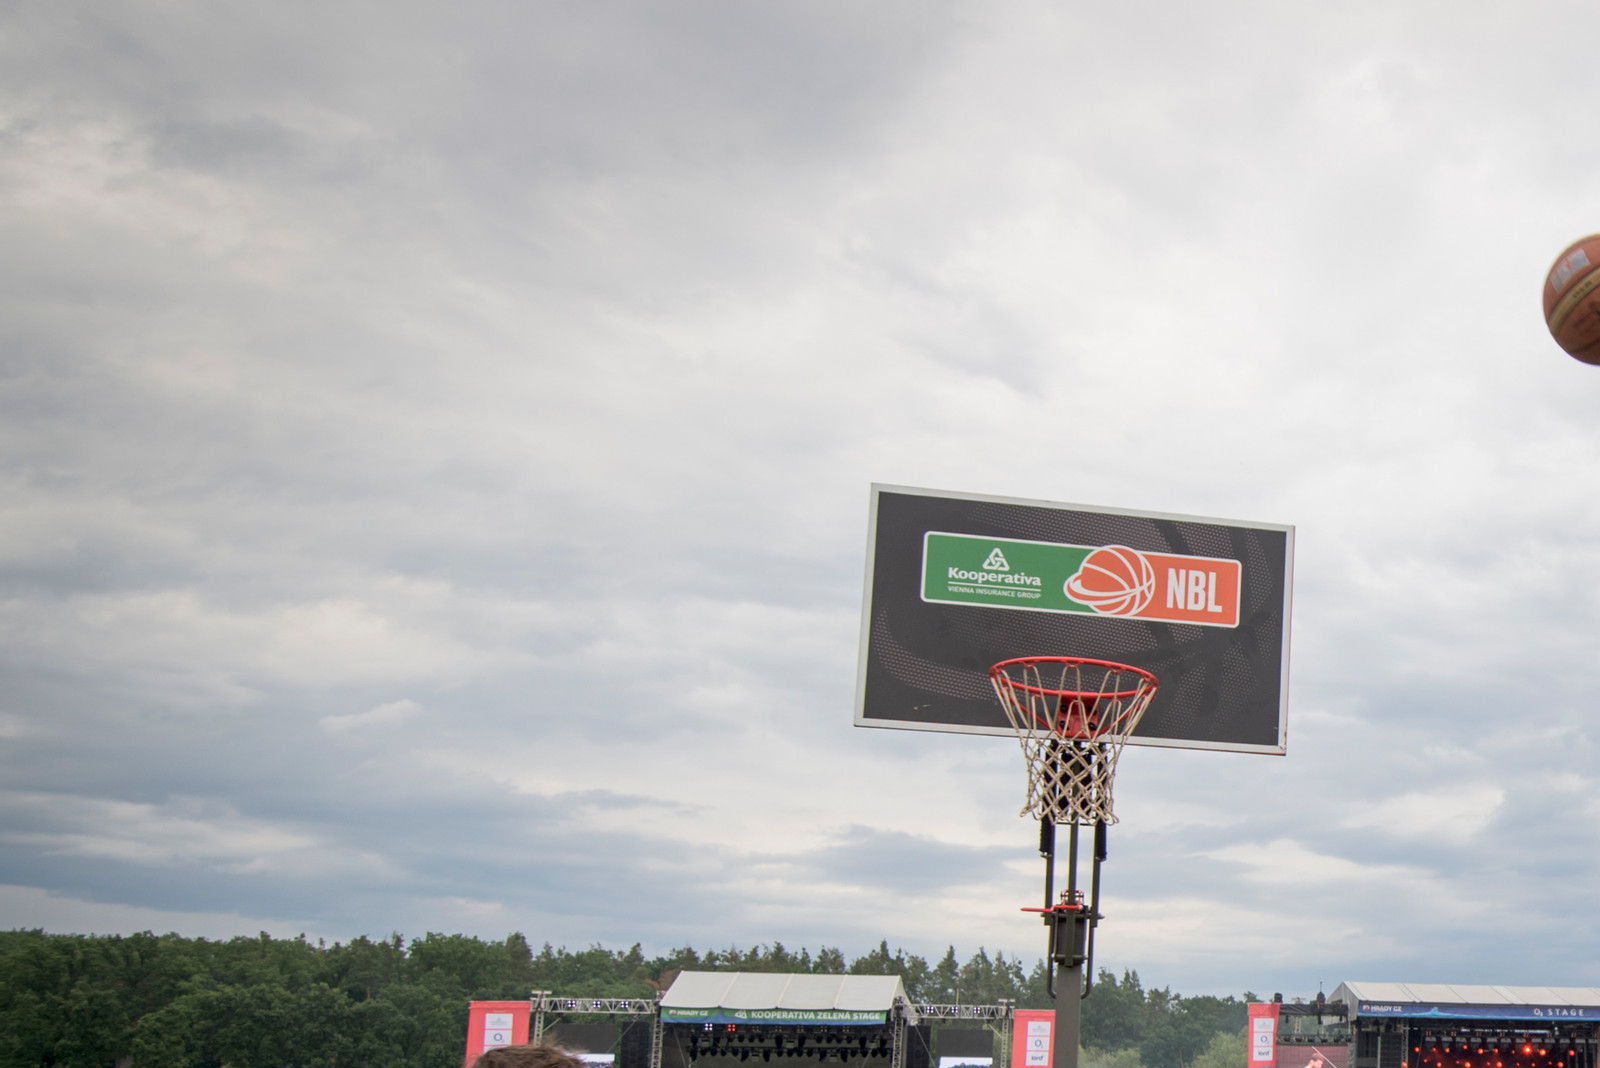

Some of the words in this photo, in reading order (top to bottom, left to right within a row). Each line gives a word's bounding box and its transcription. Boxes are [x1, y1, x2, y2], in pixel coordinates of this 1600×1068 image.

[948, 567, 1042, 587] Kooperativa
[948, 585, 974, 595] VIENNA
[975, 587, 1016, 598] INSURANCE
[1017, 591, 1042, 599] GROUP
[1166, 567, 1223, 613] NBL
[751, 1011, 815, 1020] KOOPERATIVA
[852, 1012, 880, 1020] STAGE
[1547, 1008, 1585, 1017] STAGE
